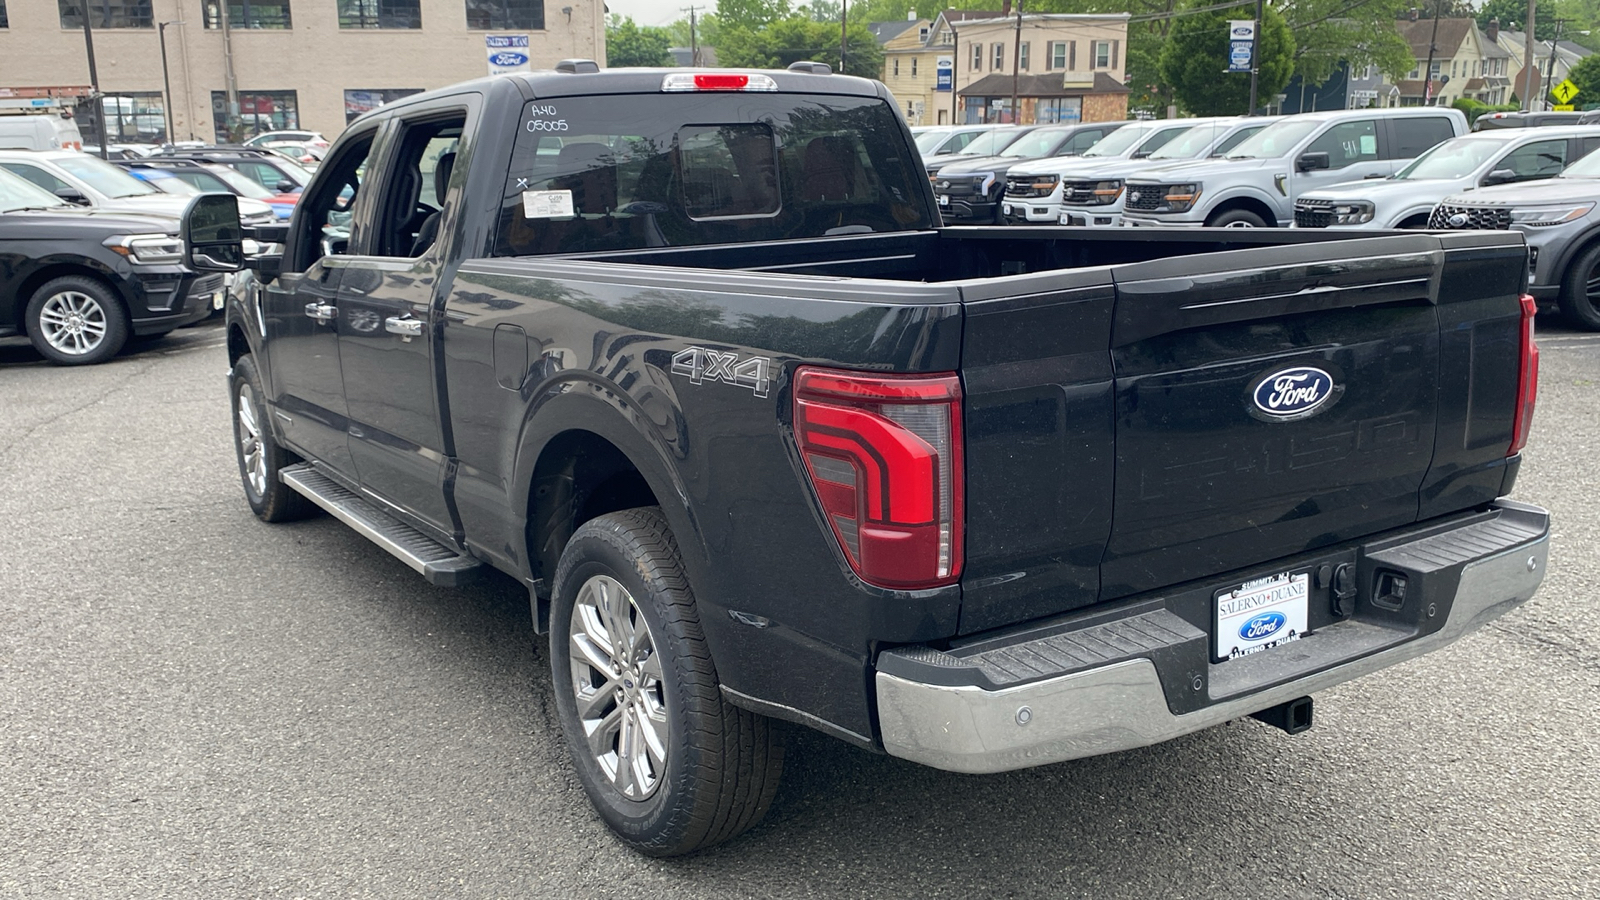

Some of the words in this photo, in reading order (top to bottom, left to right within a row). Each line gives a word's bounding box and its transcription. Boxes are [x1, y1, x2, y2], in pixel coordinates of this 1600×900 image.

[496, 54, 521, 65] Ford
[531, 105, 557, 117] A-40
[527, 119, 569, 132] 05005
[1268, 373, 1321, 409] Ford
[1278, 571, 1290, 581] NJ
[1219, 593, 1266, 616] SALERNO
[1271, 582, 1306, 603] DUANE
[1247, 615, 1279, 638] Ford
[1228, 644, 1266, 661] SALERNO
[1275, 633, 1302, 647] DUANE
